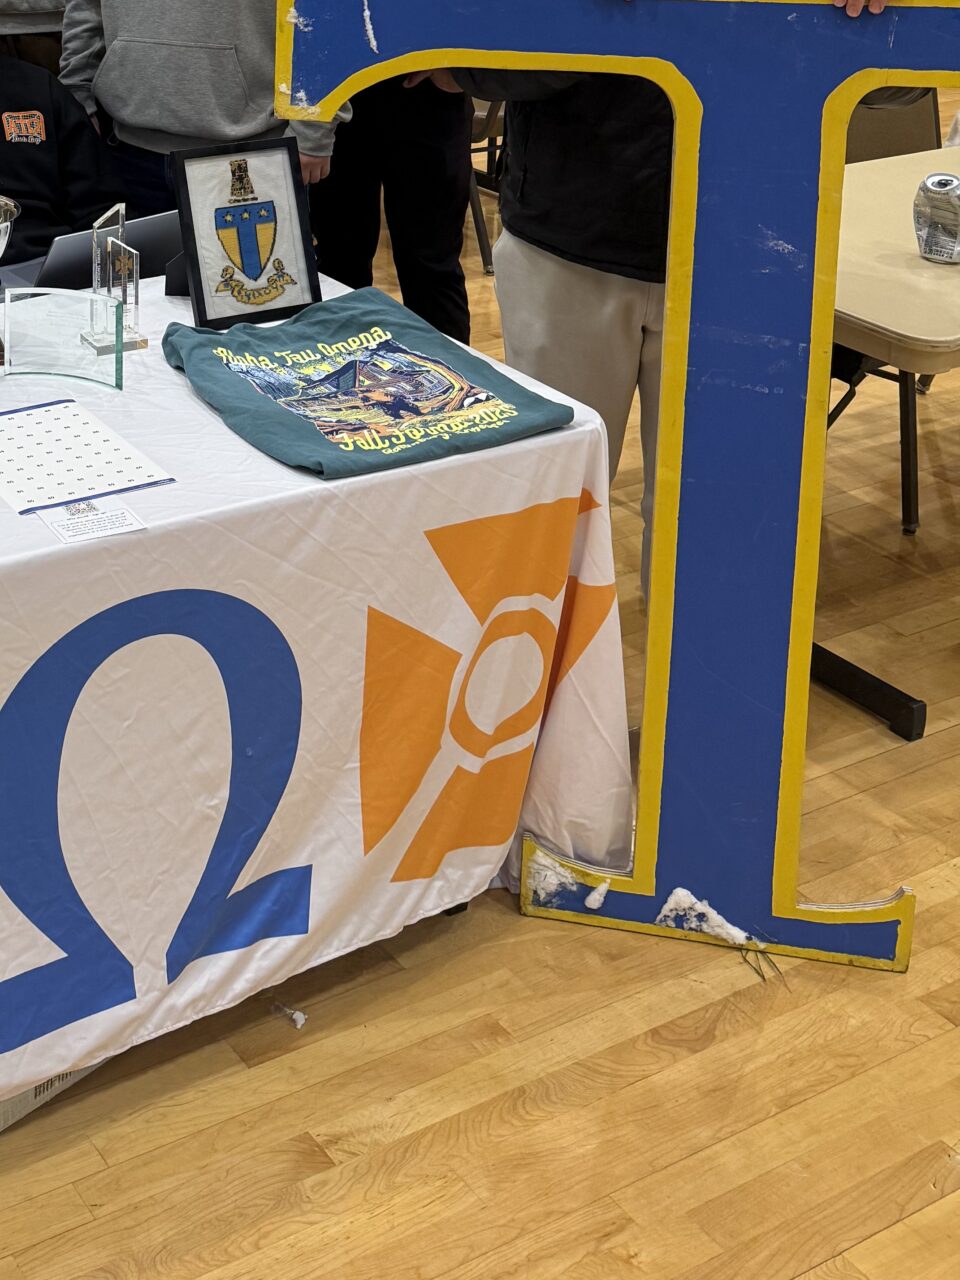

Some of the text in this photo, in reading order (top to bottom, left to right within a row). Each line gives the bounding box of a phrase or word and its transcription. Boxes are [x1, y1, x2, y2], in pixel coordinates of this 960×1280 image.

[212, 326, 392, 370] Alpha Tau Omega
[336, 429, 390, 451] Fall
